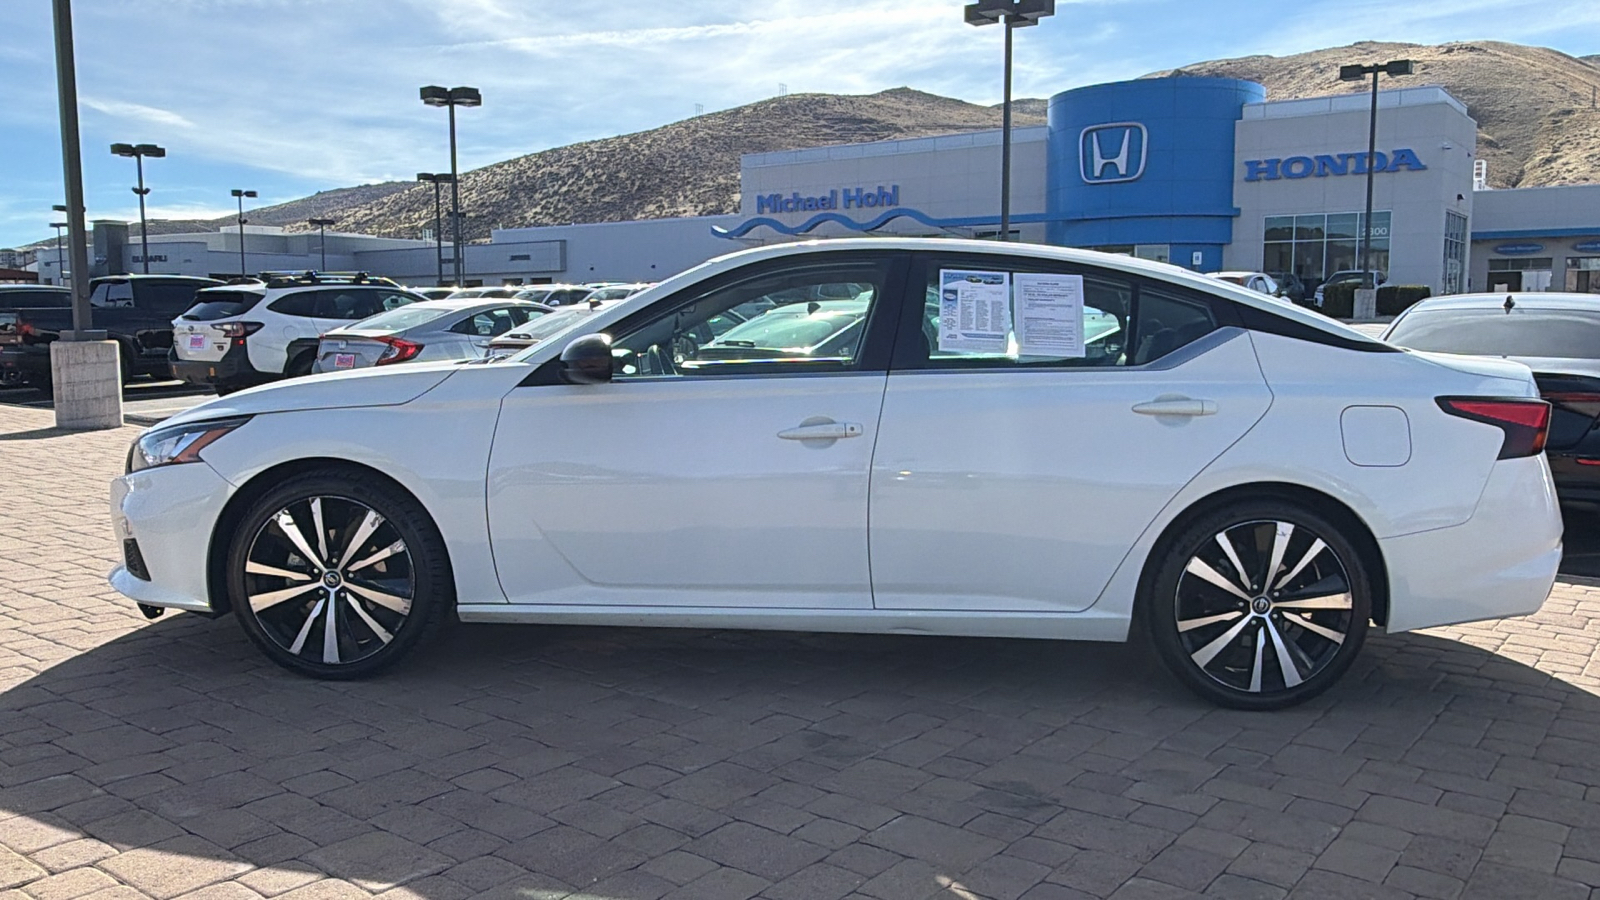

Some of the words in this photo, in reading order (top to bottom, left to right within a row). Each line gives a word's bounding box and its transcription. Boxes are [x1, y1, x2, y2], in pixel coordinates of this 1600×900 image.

[1244, 148, 1428, 182] HONDA
[756, 189, 838, 215] Michael
[842, 184, 900, 209] Hohl
[131, 254, 168, 263] SUARU
